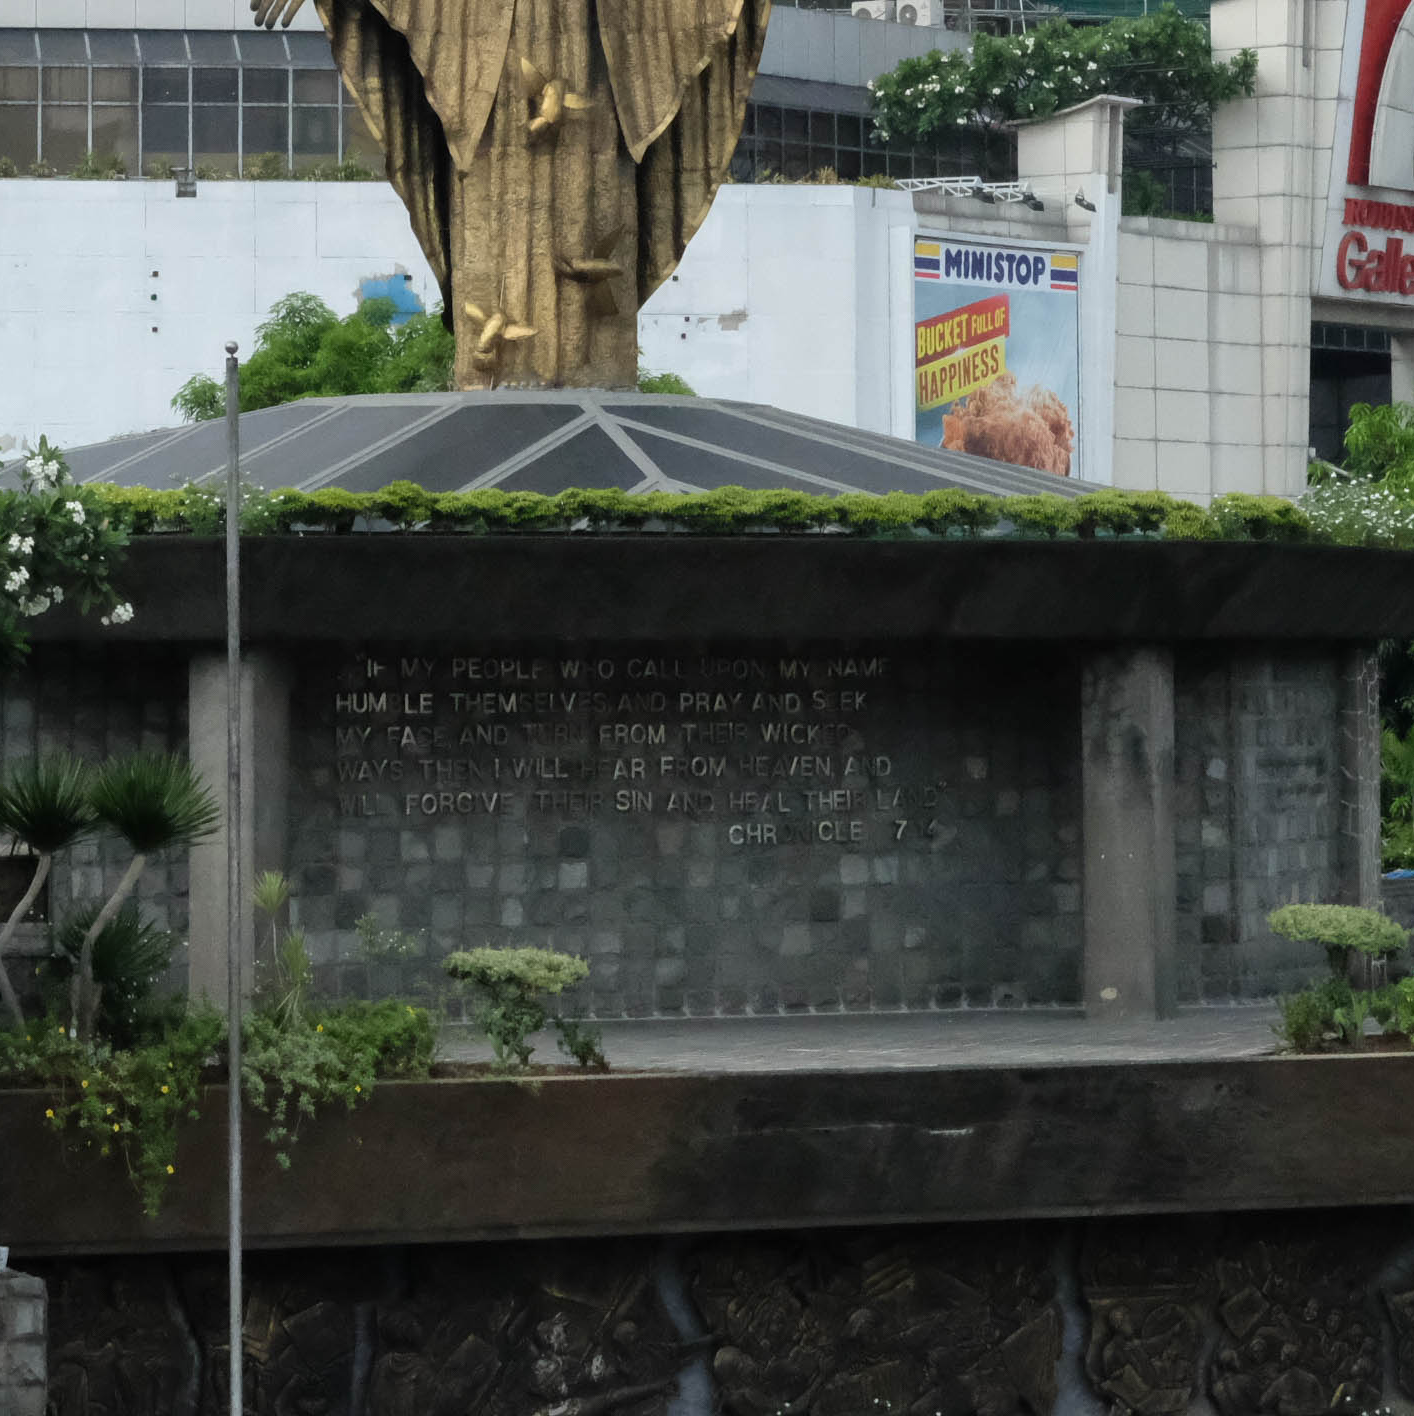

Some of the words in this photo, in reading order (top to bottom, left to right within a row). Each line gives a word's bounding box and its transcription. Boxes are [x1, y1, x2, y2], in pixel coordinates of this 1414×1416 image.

[944, 247, 1046, 286] MINISTOP
[917, 312, 969, 359] BUCKET
[971, 312, 993, 337] FULL
[994, 306, 1006, 329] OF
[919, 344, 1000, 406] HAPPINESS
[401, 658, 437, 677] MY
[452, 658, 544, 679] PEOPLE
[627, 659, 686, 679] CALL
[779, 659, 811, 678] MY
[618, 692, 666, 713] AND
[679, 692, 742, 713] PRAY
[751, 692, 801, 713] AND
[337, 727, 372, 747] MY
[459, 725, 508, 745] AND
[599, 724, 666, 745] FROM
[338, 759, 404, 781] WAYS
[512, 757, 569, 779] WILL
[844, 755, 892, 777] AND
[616, 790, 653, 813] SIN
[666, 791, 715, 813] AND
[729, 820, 864, 845] CHRICLE
